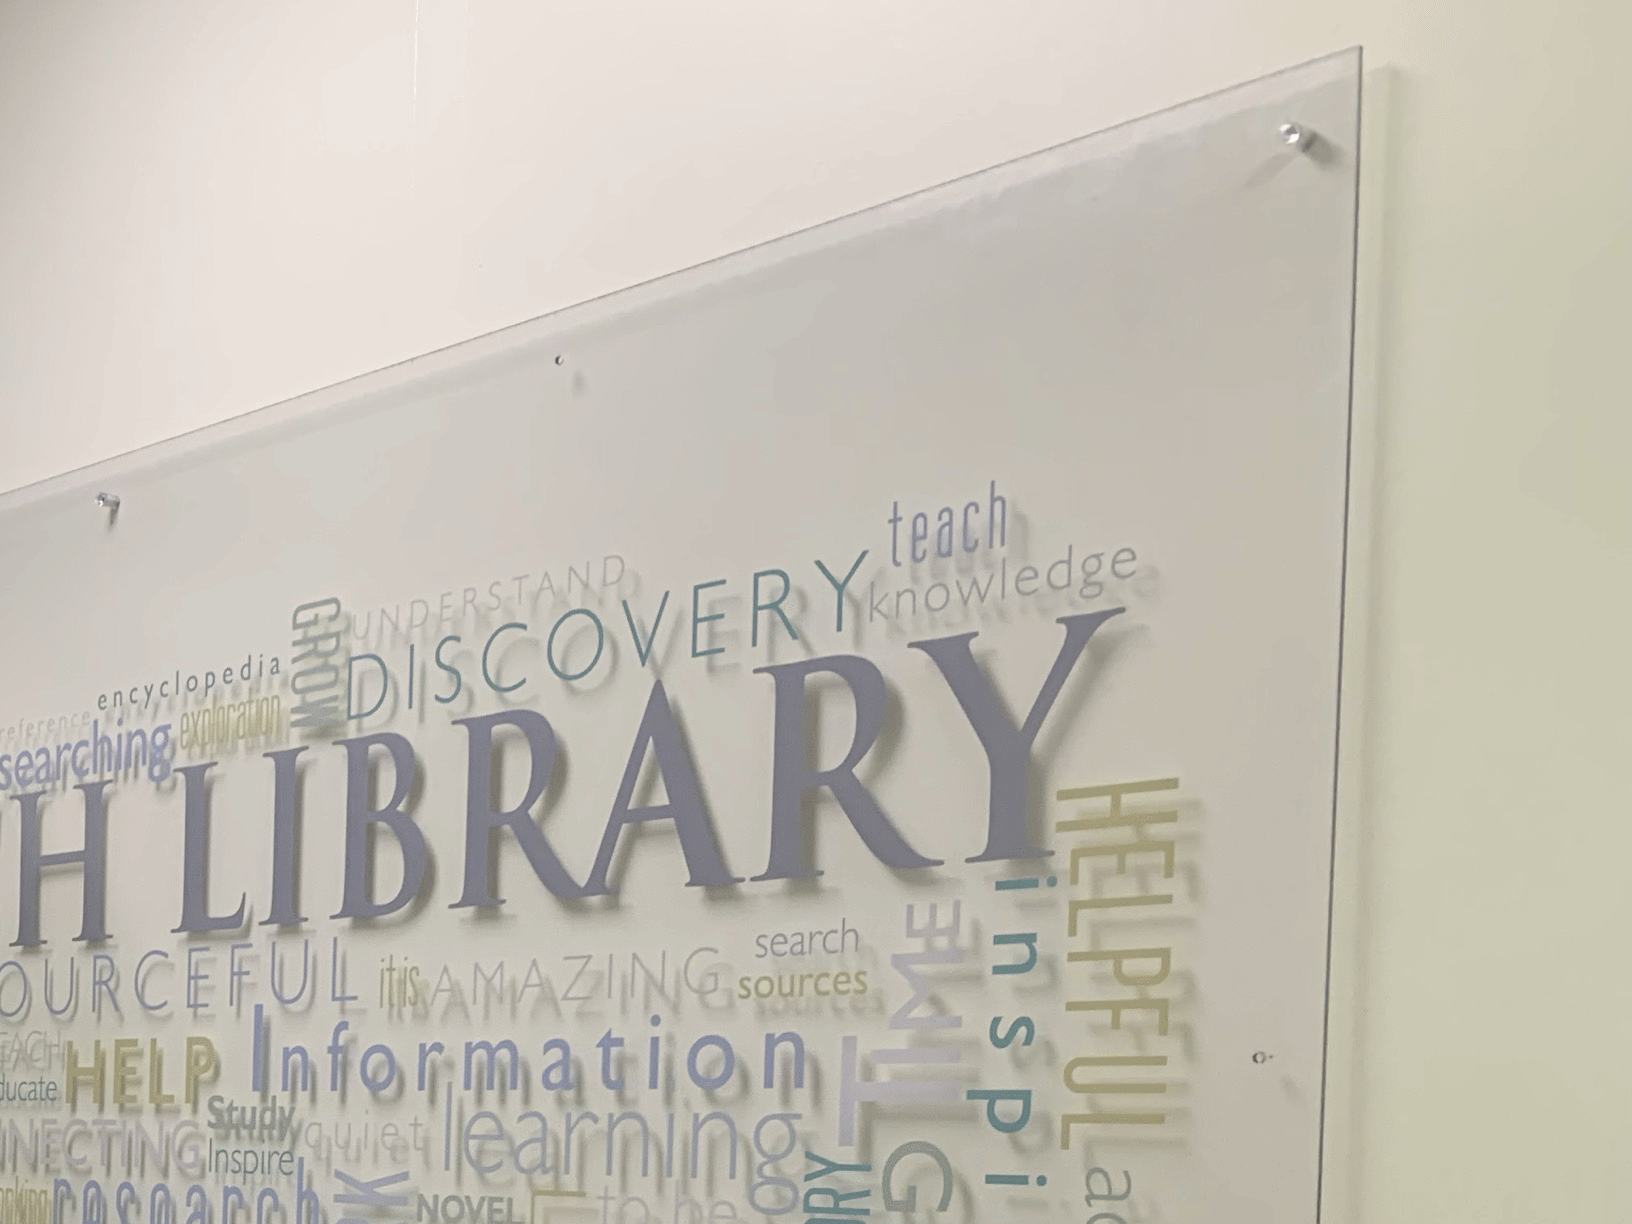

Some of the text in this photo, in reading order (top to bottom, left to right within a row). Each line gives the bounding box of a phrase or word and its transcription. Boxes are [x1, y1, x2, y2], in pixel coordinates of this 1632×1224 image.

[887, 480, 1008, 567] teach
[353, 555, 624, 641] UNDERSTAND
[870, 544, 1137, 623] knowledge
[290, 597, 342, 728] GROW
[347, 550, 869, 720] DISCOVERY
[97, 654, 280, 710] encyclopedia
[180, 694, 280, 754] exploration
[172, 607, 1127, 934] LIBRARY
[430, 947, 719, 1005] AMAZING
[755, 917, 859, 959] search
[1056, 776, 1180, 1150] HELPFUL
[738, 969, 868, 1000] sources
[838, 900, 966, 1147] TIME
[65, 1036, 217, 1105] HELP
[252, 1003, 805, 1092] Information
[207, 1095, 297, 1142] Study
[305, 1109, 424, 1160] quiet
[444, 1081, 802, 1216] learning
[209, 1138, 295, 1184] Inspire
